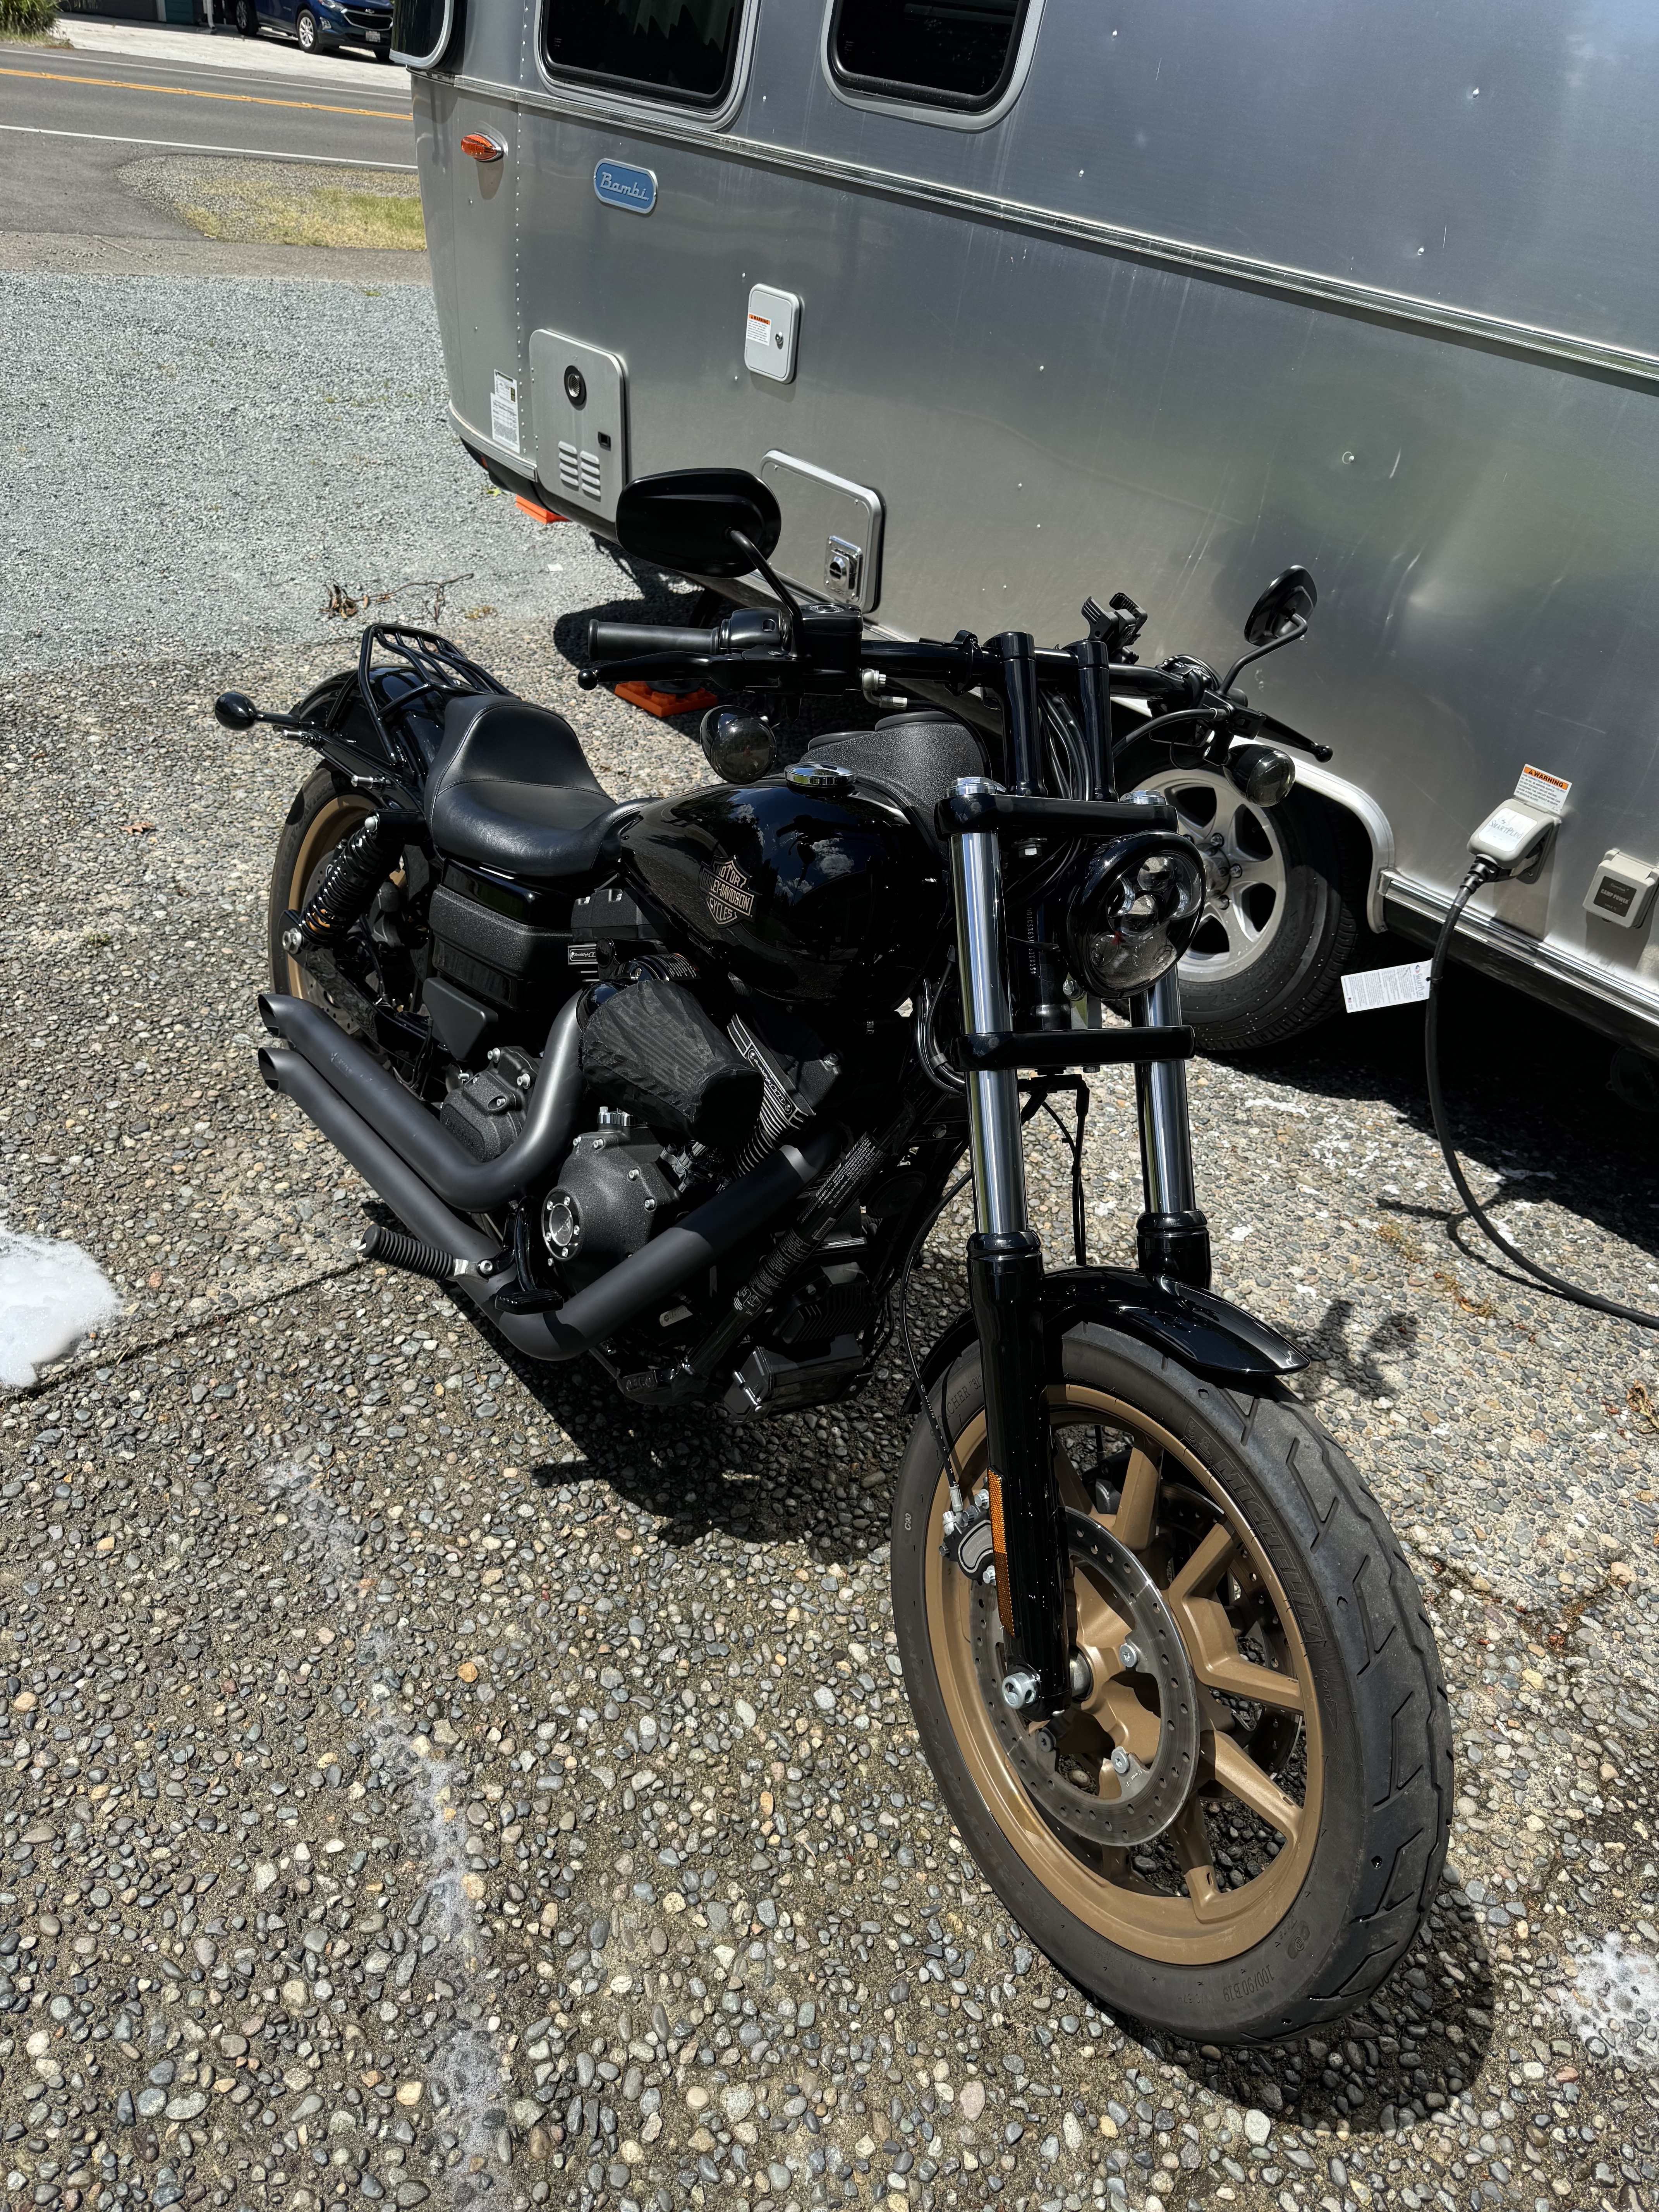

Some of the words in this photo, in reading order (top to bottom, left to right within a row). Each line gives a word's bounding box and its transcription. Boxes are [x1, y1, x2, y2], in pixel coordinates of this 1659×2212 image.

[600, 172, 649, 201] Bambi
[1534, 771, 1563, 787] WARNING
[716, 864, 740, 886] MOTOR
[702, 872, 750, 910] HARLEY-DAVIDSON
[1601, 889, 1613, 897] CAMP
[1613, 894, 1629, 904] POWER
[709, 898, 733, 921] CYCLES
[1215, 1458, 1324, 1638] MICHELIN
